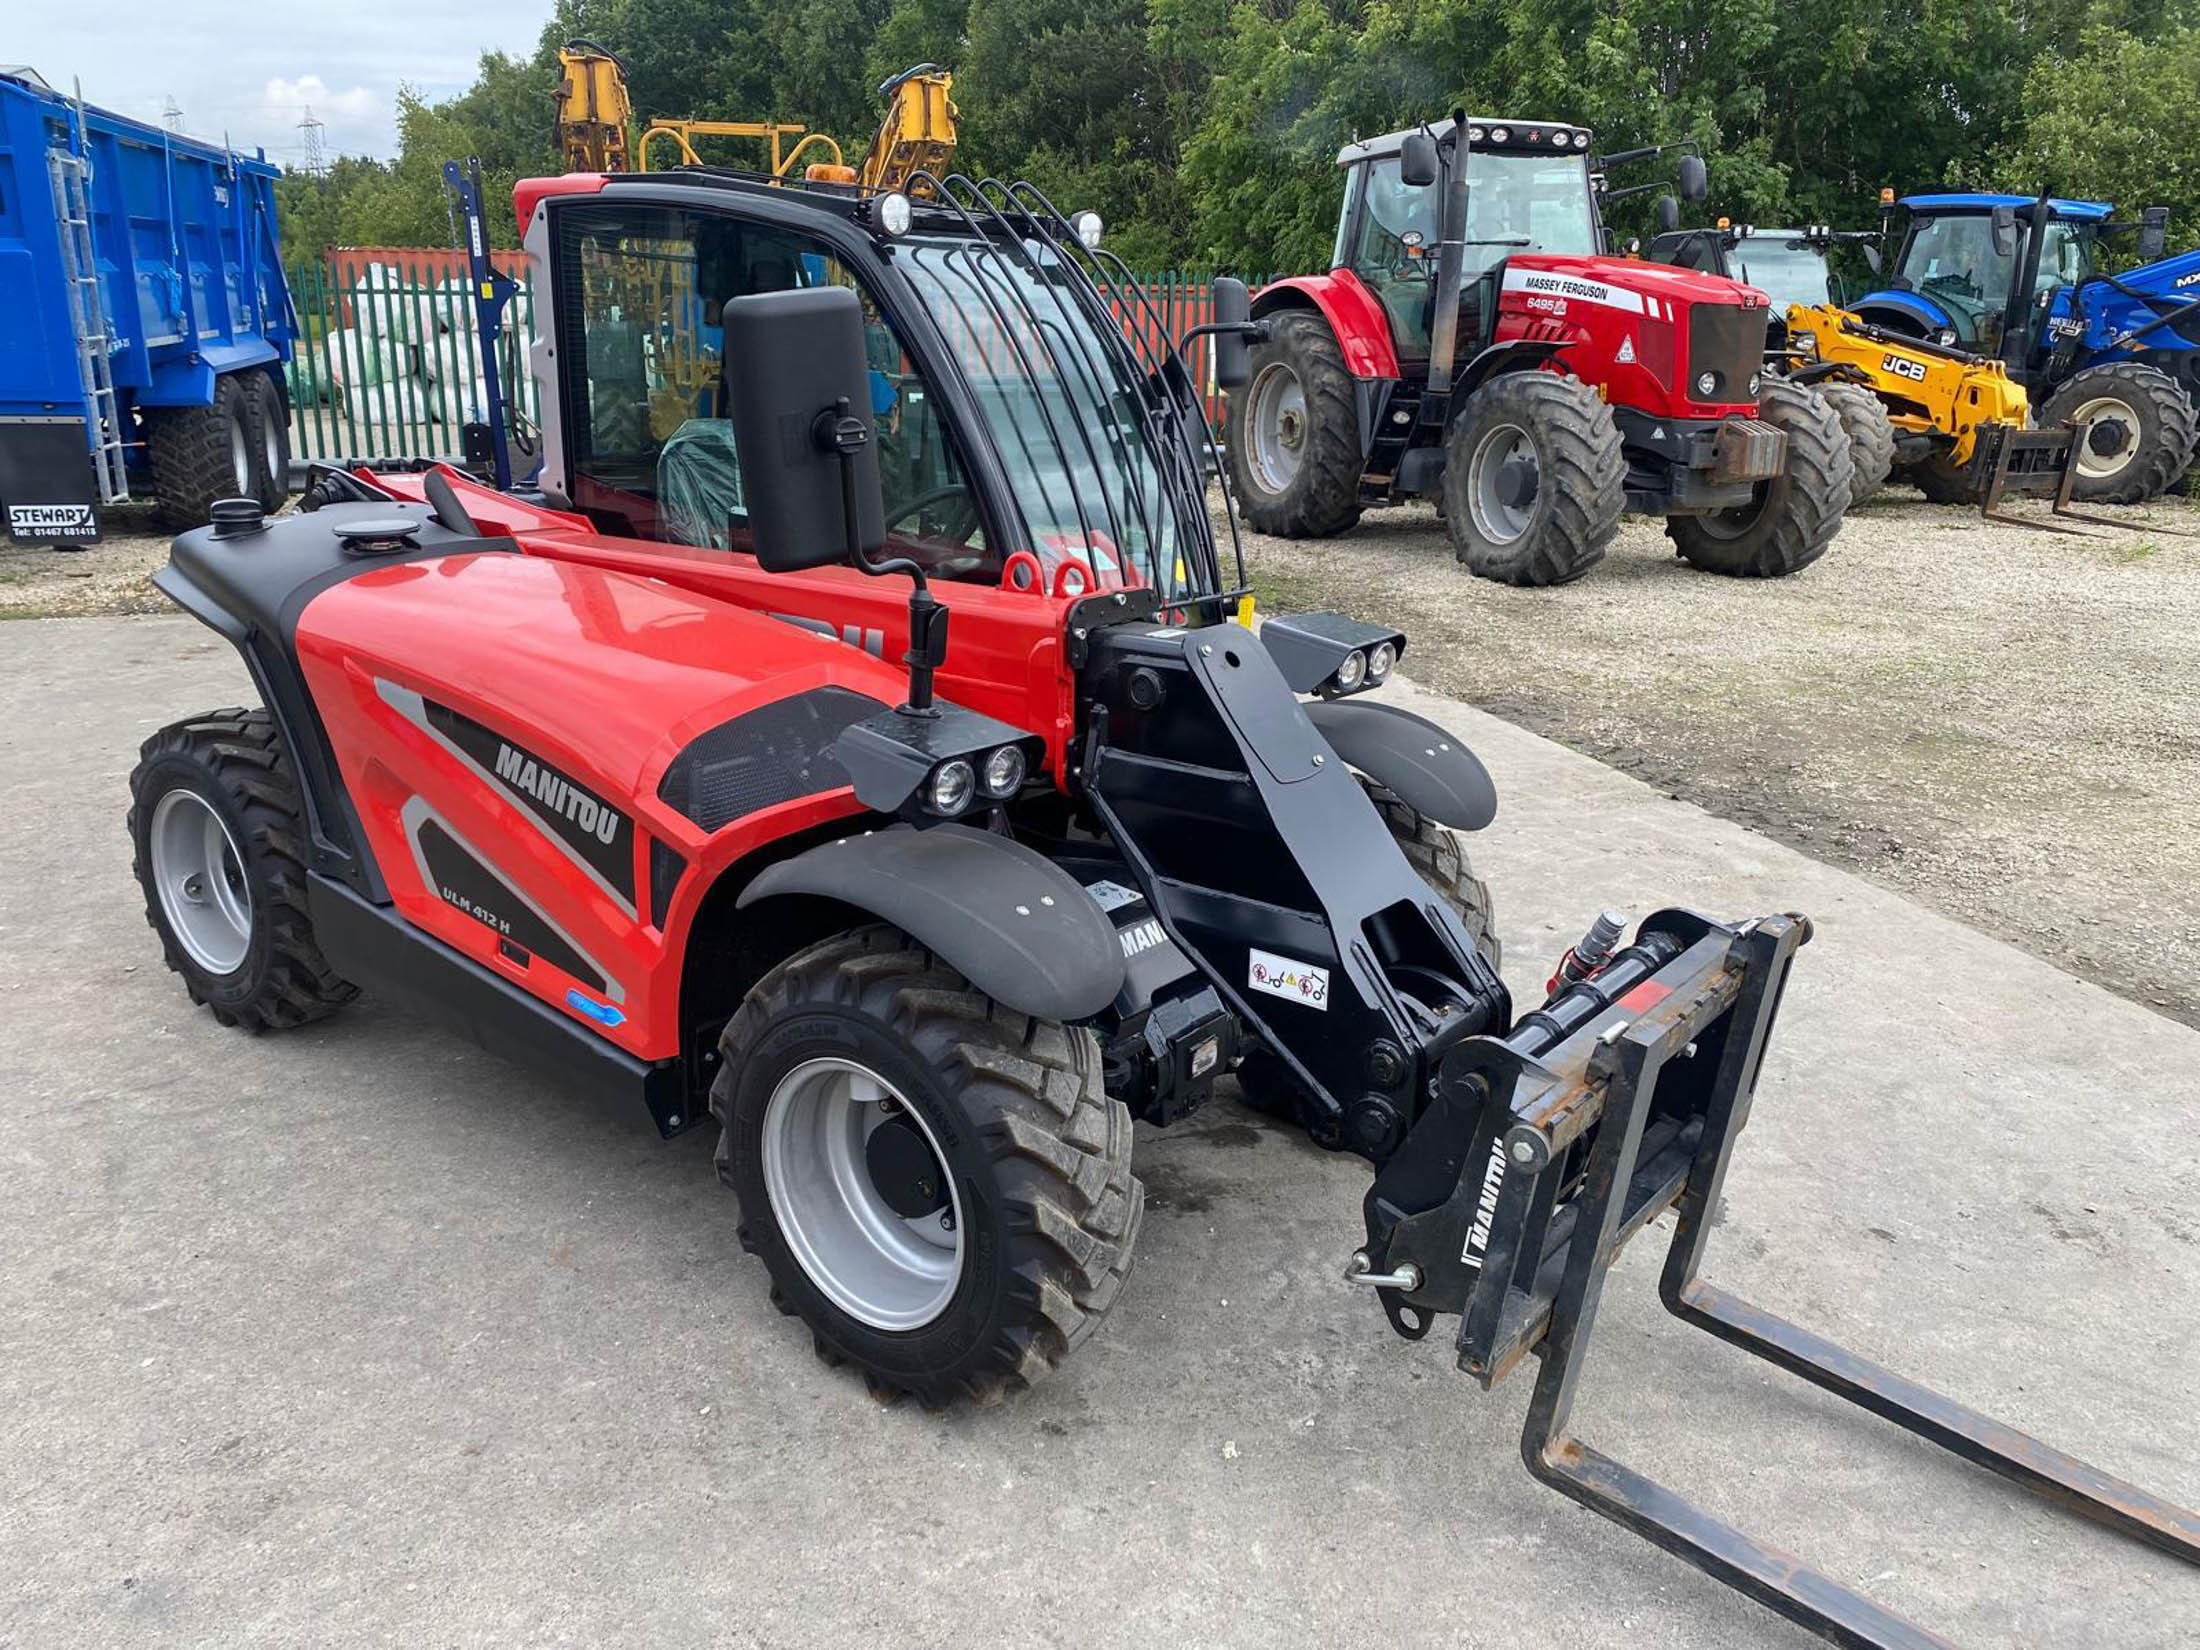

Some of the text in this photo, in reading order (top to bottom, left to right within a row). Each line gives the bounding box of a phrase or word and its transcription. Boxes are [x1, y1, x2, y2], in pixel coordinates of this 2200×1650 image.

[1525, 277, 1608, 300] MASSEY FERGUSON
[1527, 297, 1555, 311] 6495
[1882, 356, 1926, 381] JCB
[11, 508, 90, 523] STEWART
[495, 743, 619, 845] MANITOU
[443, 887, 511, 934] ULM 412 H
